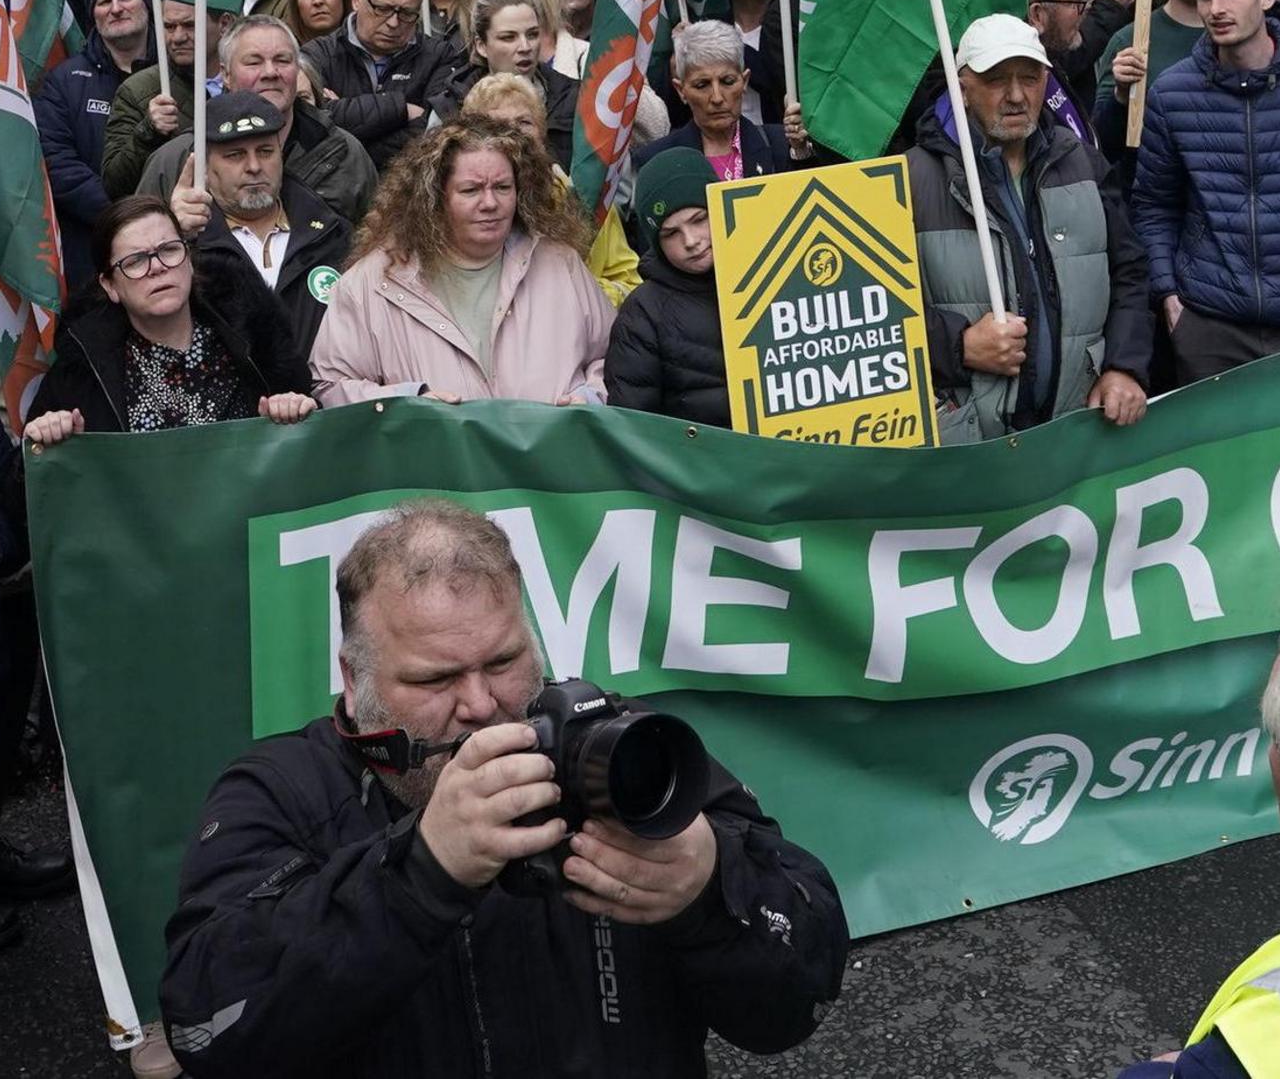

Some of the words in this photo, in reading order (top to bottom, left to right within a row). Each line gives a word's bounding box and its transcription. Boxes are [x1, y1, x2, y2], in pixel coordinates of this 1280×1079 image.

[90, 102, 108, 111] AIG
[771, 284, 889, 342] BUILD
[763, 324, 904, 368] AFFORDABLE
[766, 350, 909, 415] HOMES
[851, 407, 917, 446] Féin
[279, 506, 803, 695] TME
[863, 466, 1225, 684] FOR
[574, 697, 607, 713] Canon
[1089, 727, 1261, 802] Sinn
